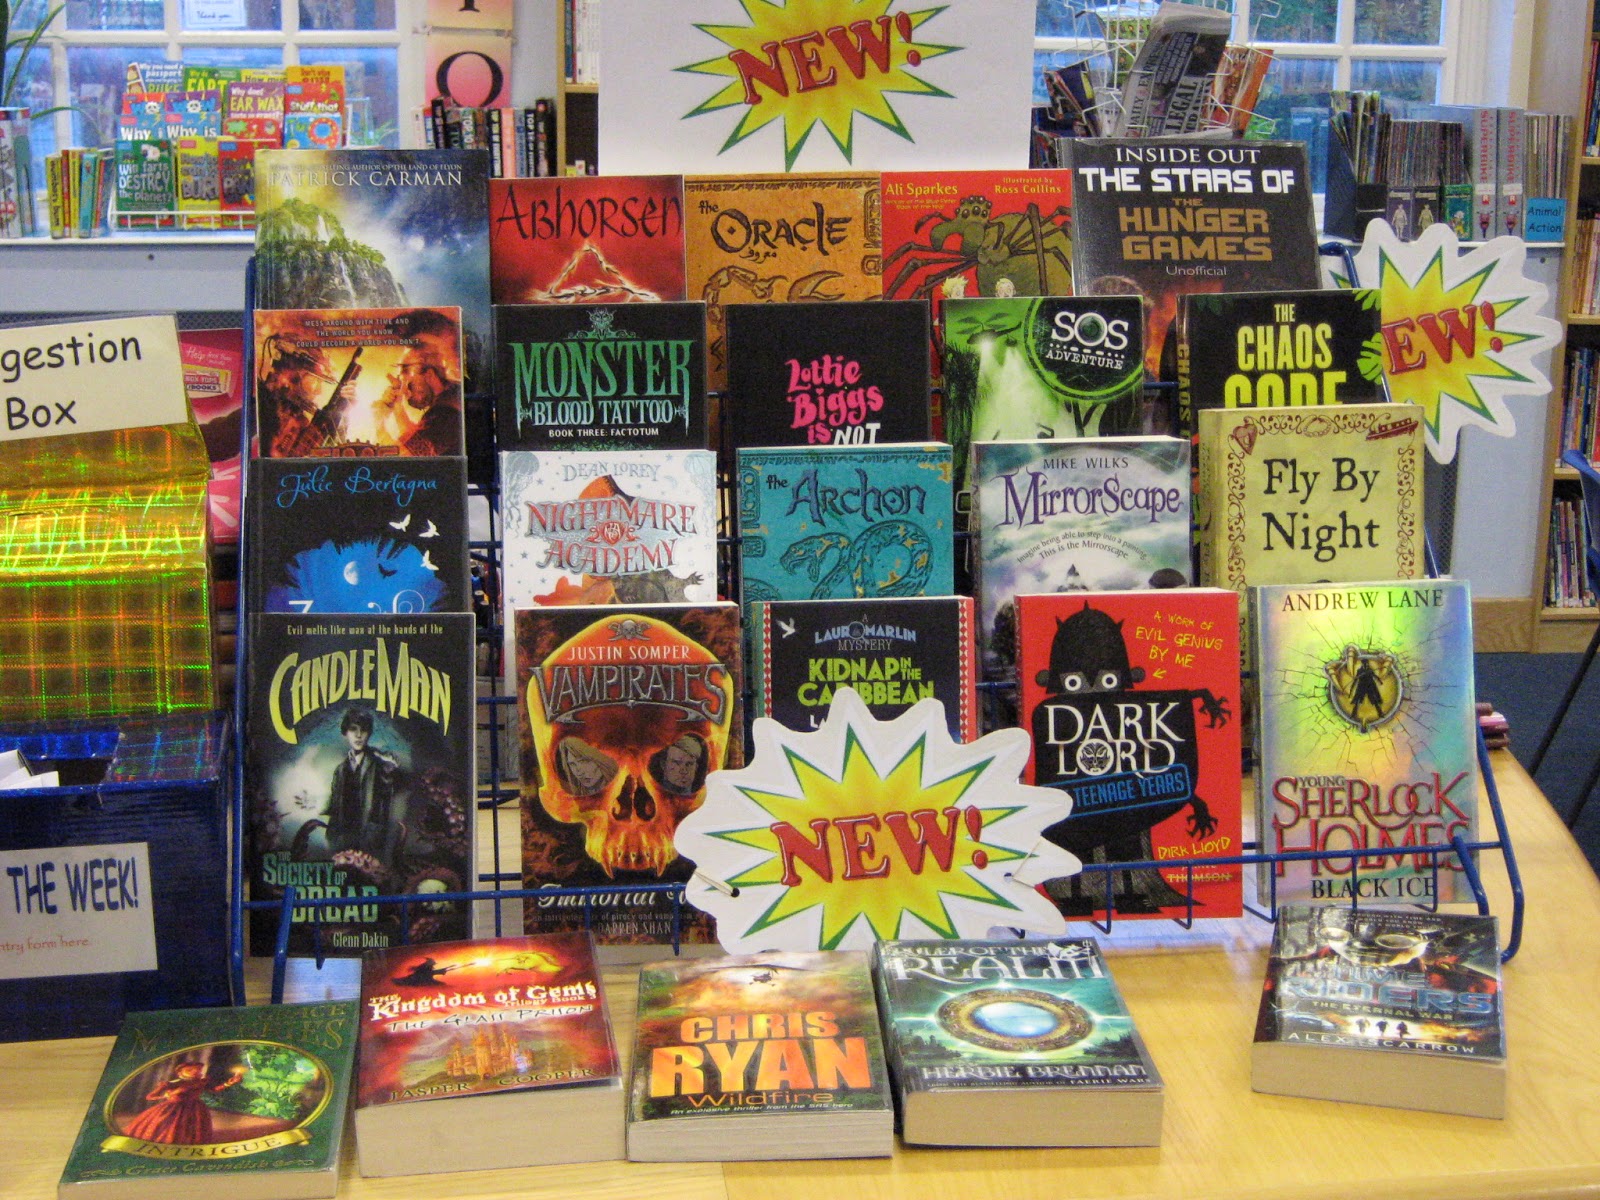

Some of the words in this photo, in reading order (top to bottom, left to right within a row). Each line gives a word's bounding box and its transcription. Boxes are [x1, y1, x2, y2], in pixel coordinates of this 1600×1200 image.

[728, 11, 922, 105] NEW!
[230, 96, 254, 112] EAR
[257, 96, 285, 112] WAX
[121, 127, 151, 141] Why
[167, 125, 197, 139] Why
[204, 126, 217, 137] is
[1115, 147, 1201, 165] INSIDE
[1207, 148, 1261, 165] OUT
[269, 171, 361, 187] PATRICK
[369, 171, 462, 186] CARMAN
[885, 183, 903, 196] Ali
[906, 182, 959, 198] Sparkes
[995, 184, 1019, 194] Ross
[1022, 184, 1062, 194] Collins
[1078, 168, 1141, 193] THE
[1150, 168, 1253, 194] STARS
[1262, 169, 1296, 194] OF
[1172, 198, 1203, 207] THE
[1527, 206, 1562, 217] Animal
[1118, 208, 1271, 233] HUNGER
[1528, 223, 1562, 233] Action
[1121, 235, 1273, 262] GAMES
[1165, 265, 1228, 277] Unofficial
[1273, 303, 1296, 323] THE
[1051, 310, 1131, 351] SOS
[1381, 300, 1504, 376] EW!
[0, 332, 142, 383] gestion
[1044, 349, 1125, 371] ADVENTURE
[1236, 323, 1333, 374] CHAOS
[507, 339, 695, 414] MONSTER
[785, 353, 863, 392] Lottie
[1177, 343, 1191, 422] CHAOS
[5, 396, 77, 431] Box
[532, 400, 595, 426] BLOOD
[600, 399, 674, 425] TATTOO
[786, 385, 885, 430] Biggs
[548, 428, 574, 438] BOOK
[576, 427, 608, 437] THREE:
[610, 427, 660, 437] FACTOTUM
[807, 424, 833, 445] is
[833, 423, 881, 445] NOT
[562, 460, 609, 482] DEAN
[613, 461, 662, 482] LOREY
[1043, 457, 1078, 470] MIKE
[1085, 456, 1129, 469] WILKS
[276, 464, 333, 508] Julie
[344, 466, 439, 507] Bertagna
[1262, 458, 1320, 505] Fly
[1331, 457, 1380, 503] By
[525, 494, 698, 538] NIGHTMARE
[1016, 543, 1040, 563] Imagine
[1041, 535, 1061, 547] being
[1061, 531, 1077, 541] able
[1087, 531, 1102, 540] step
[1261, 510, 1380, 563] Night
[536, 538, 678, 576] ACADEMY
[1038, 547, 1057, 560] This
[1066, 541, 1080, 550] the
[1282, 591, 1379, 612] ANDREW
[1387, 589, 1445, 609] LANE
[287, 624, 303, 635] Evil
[306, 625, 328, 635] melts
[330, 625, 346, 635] like
[378, 624, 392, 635] the
[394, 624, 418, 634] hands
[430, 623, 443, 634] the
[1154, 610, 1162, 623] A
[1168, 613, 1195, 628] WORK
[838, 638, 892, 651] MYSTERY
[865, 624, 917, 642] MARLIN
[1135, 626, 1167, 642] EVIL
[1174, 633, 1223, 651] GENIUS
[567, 646, 624, 661] JUSTIN
[629, 645, 691, 660] SOMPER
[1149, 645, 1168, 661] BY
[1175, 653, 1196, 669] ME
[808, 657, 899, 682] KIDNAP
[901, 668, 922, 681] THE
[268, 637, 452, 745] CANDLEMAN
[528, 663, 729, 725] VAMPIRATES
[797, 680, 935, 707] CAIBBEAN
[1044, 702, 1186, 748] DARK
[1056, 739, 1177, 778] LORD
[1074, 778, 1136, 808] TEENAGE
[1137, 771, 1185, 797] YEARS
[1297, 775, 1346, 788] YOUNG
[1272, 772, 1471, 830] SHERLOCK
[769, 804, 989, 888] NEW!
[1157, 846, 1190, 860] DIRK
[1274, 818, 1470, 877] HOLMES
[262, 852, 335, 886] SOCIETY
[334, 871, 348, 886] OF
[6, 861, 58, 915] THE
[64, 856, 139, 913] WEEK!
[1311, 877, 1391, 899] BLACK
[1396, 876, 1436, 898] ICE
[332, 932, 360, 948] Glenn
[362, 931, 389, 948] Dakin
[642, 921, 671, 934] SHAN
[26, 936, 57, 949] form
[892, 956, 1105, 983] REALM
[368, 991, 487, 1022] Kingdom
[494, 986, 521, 1003] of
[526, 980, 597, 1001] Gems
[1281, 977, 1496, 1015] RIDERS
[516, 1004, 594, 1019] PRISON
[1418, 1010, 1454, 1021] WAR
[680, 1011, 841, 1044] CHRIS
[1288, 1031, 1350, 1044] ALEX
[1371, 1037, 1476, 1054] SCARROW
[650, 1037, 873, 1098] RYAN
[921, 1065, 1022, 1080] HERBIE
[1027, 1064, 1148, 1080] BRENNAN
[390, 1081, 472, 1102] JASPER
[499, 1067, 597, 1087] COOPER
[688, 1092, 835, 1108] Wildfire
[136, 1137, 282, 1158] INTRIGUE
